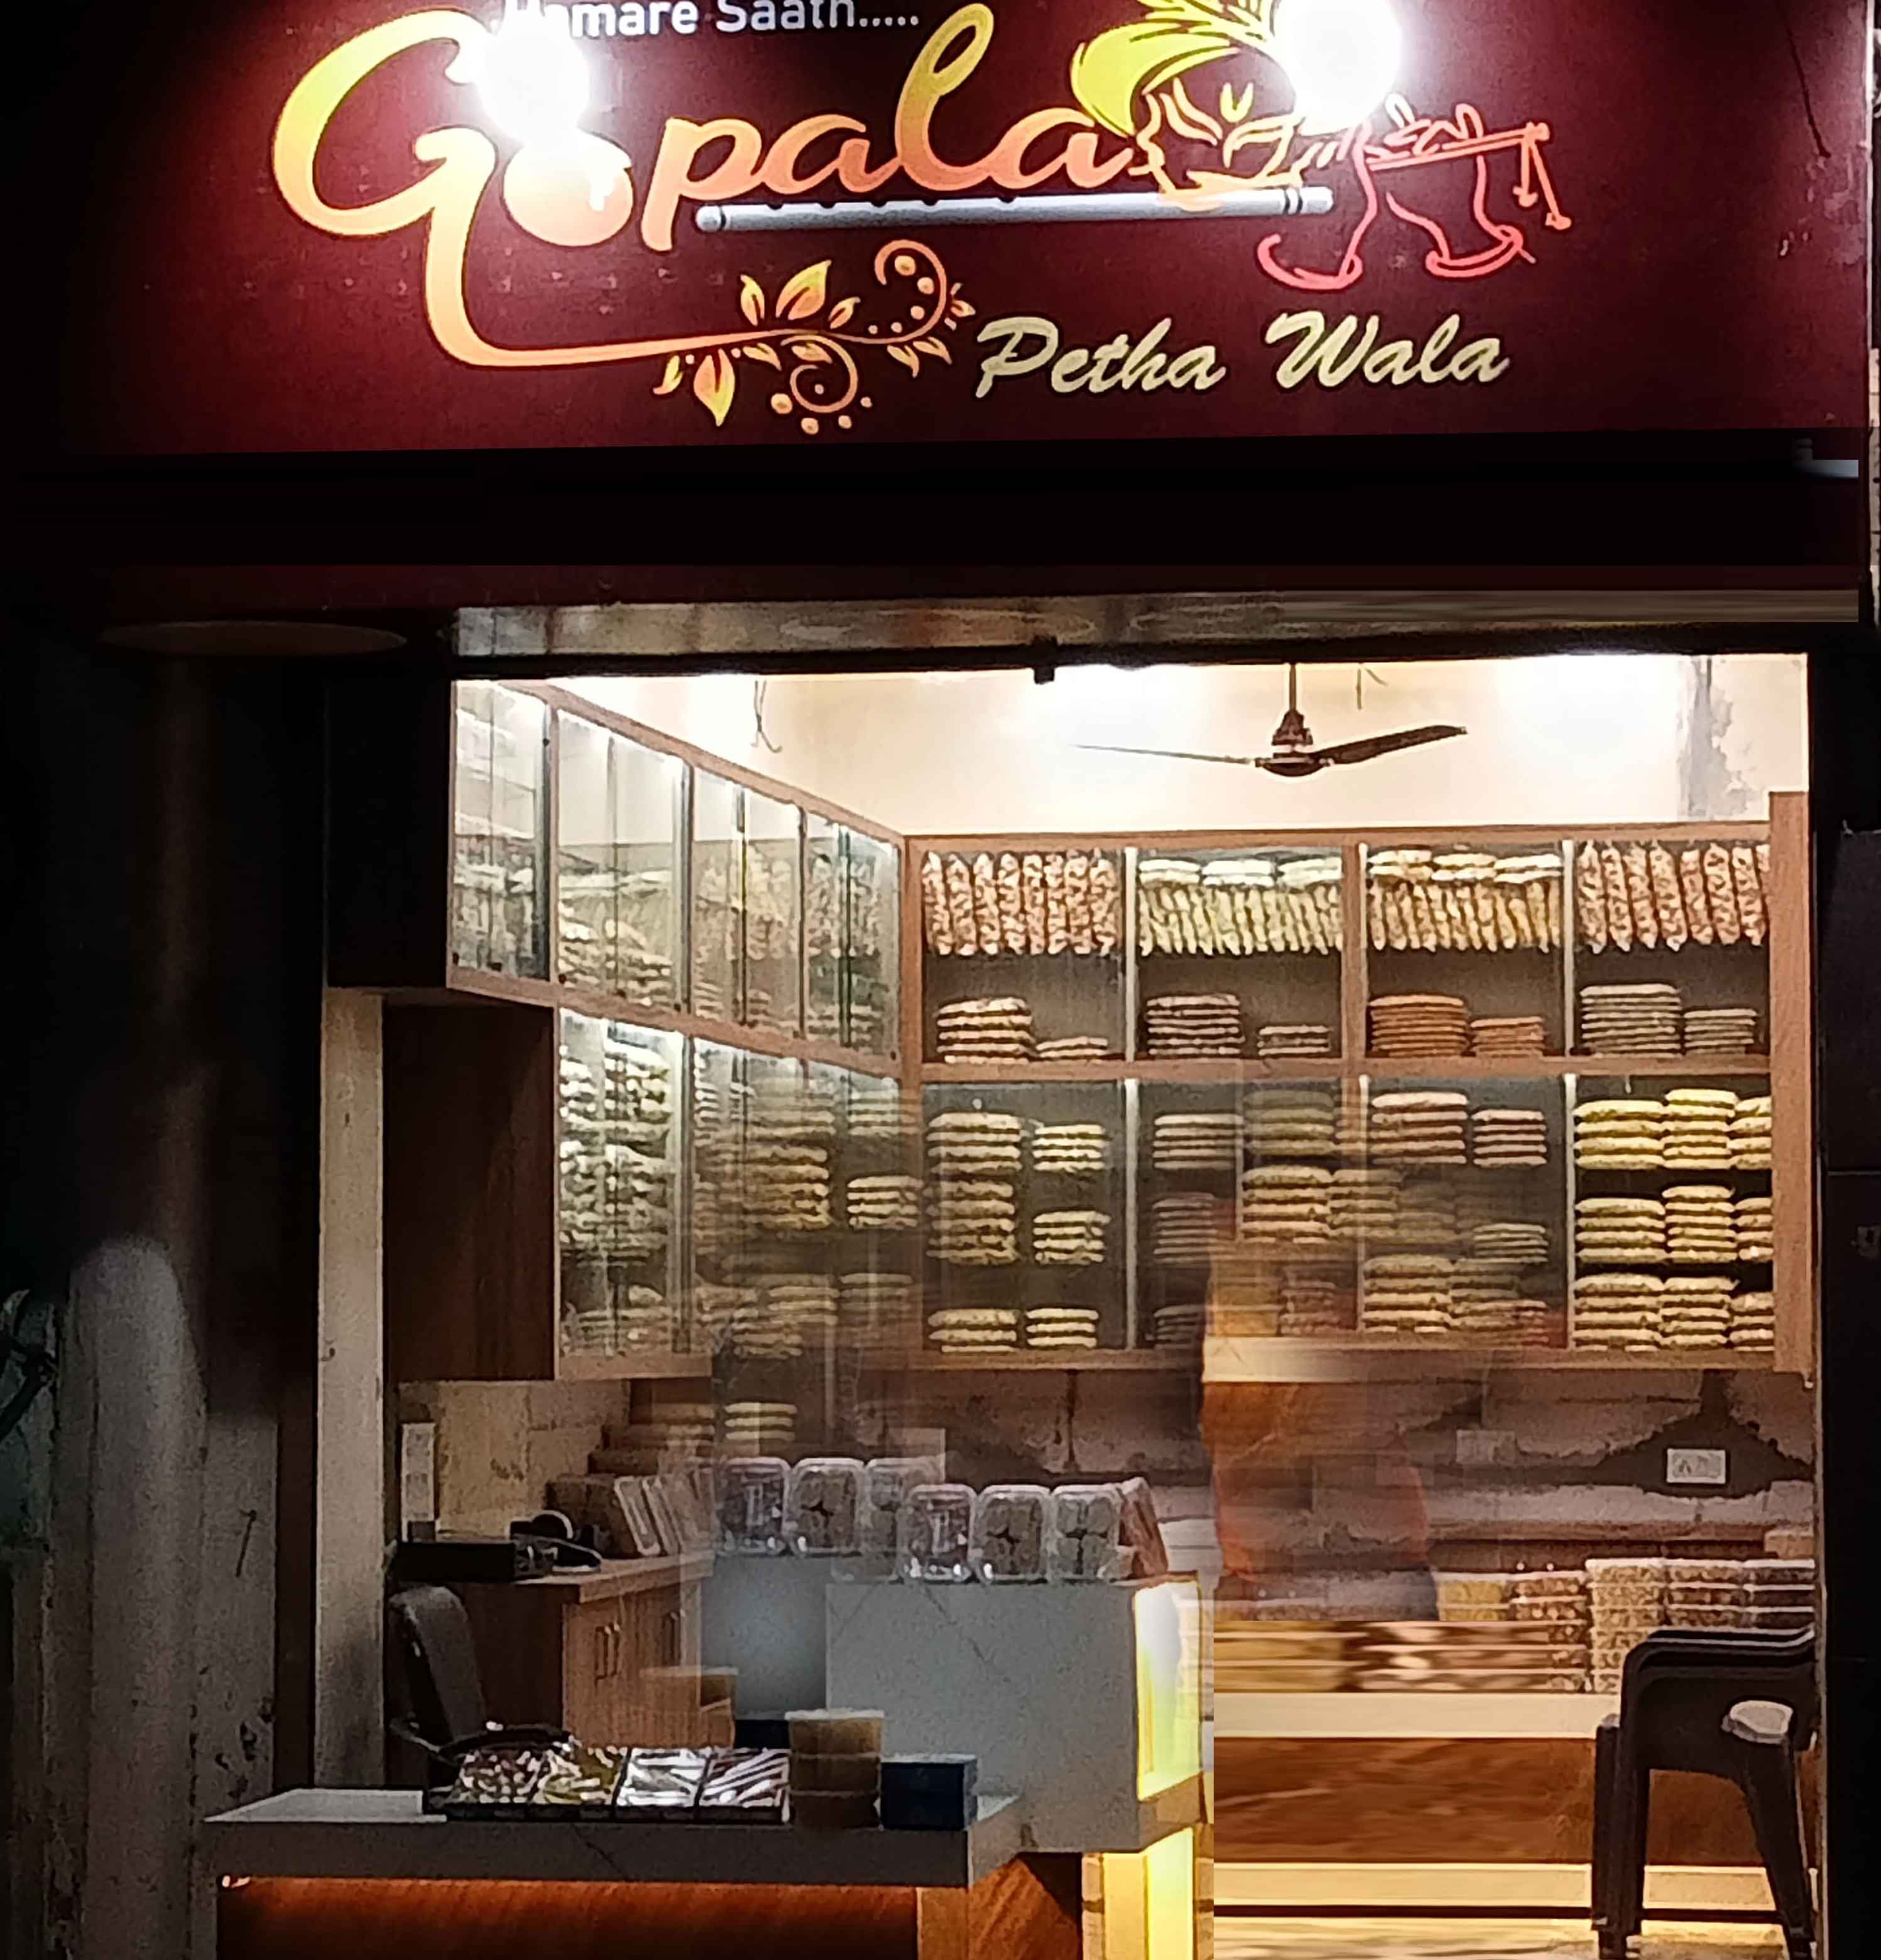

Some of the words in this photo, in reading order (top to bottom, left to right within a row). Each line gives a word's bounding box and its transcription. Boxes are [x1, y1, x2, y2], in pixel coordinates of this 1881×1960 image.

[272, 3, 1132, 368] Gopala
[975, 316, 1226, 398] Petha
[1265, 310, 1510, 389] Wala
